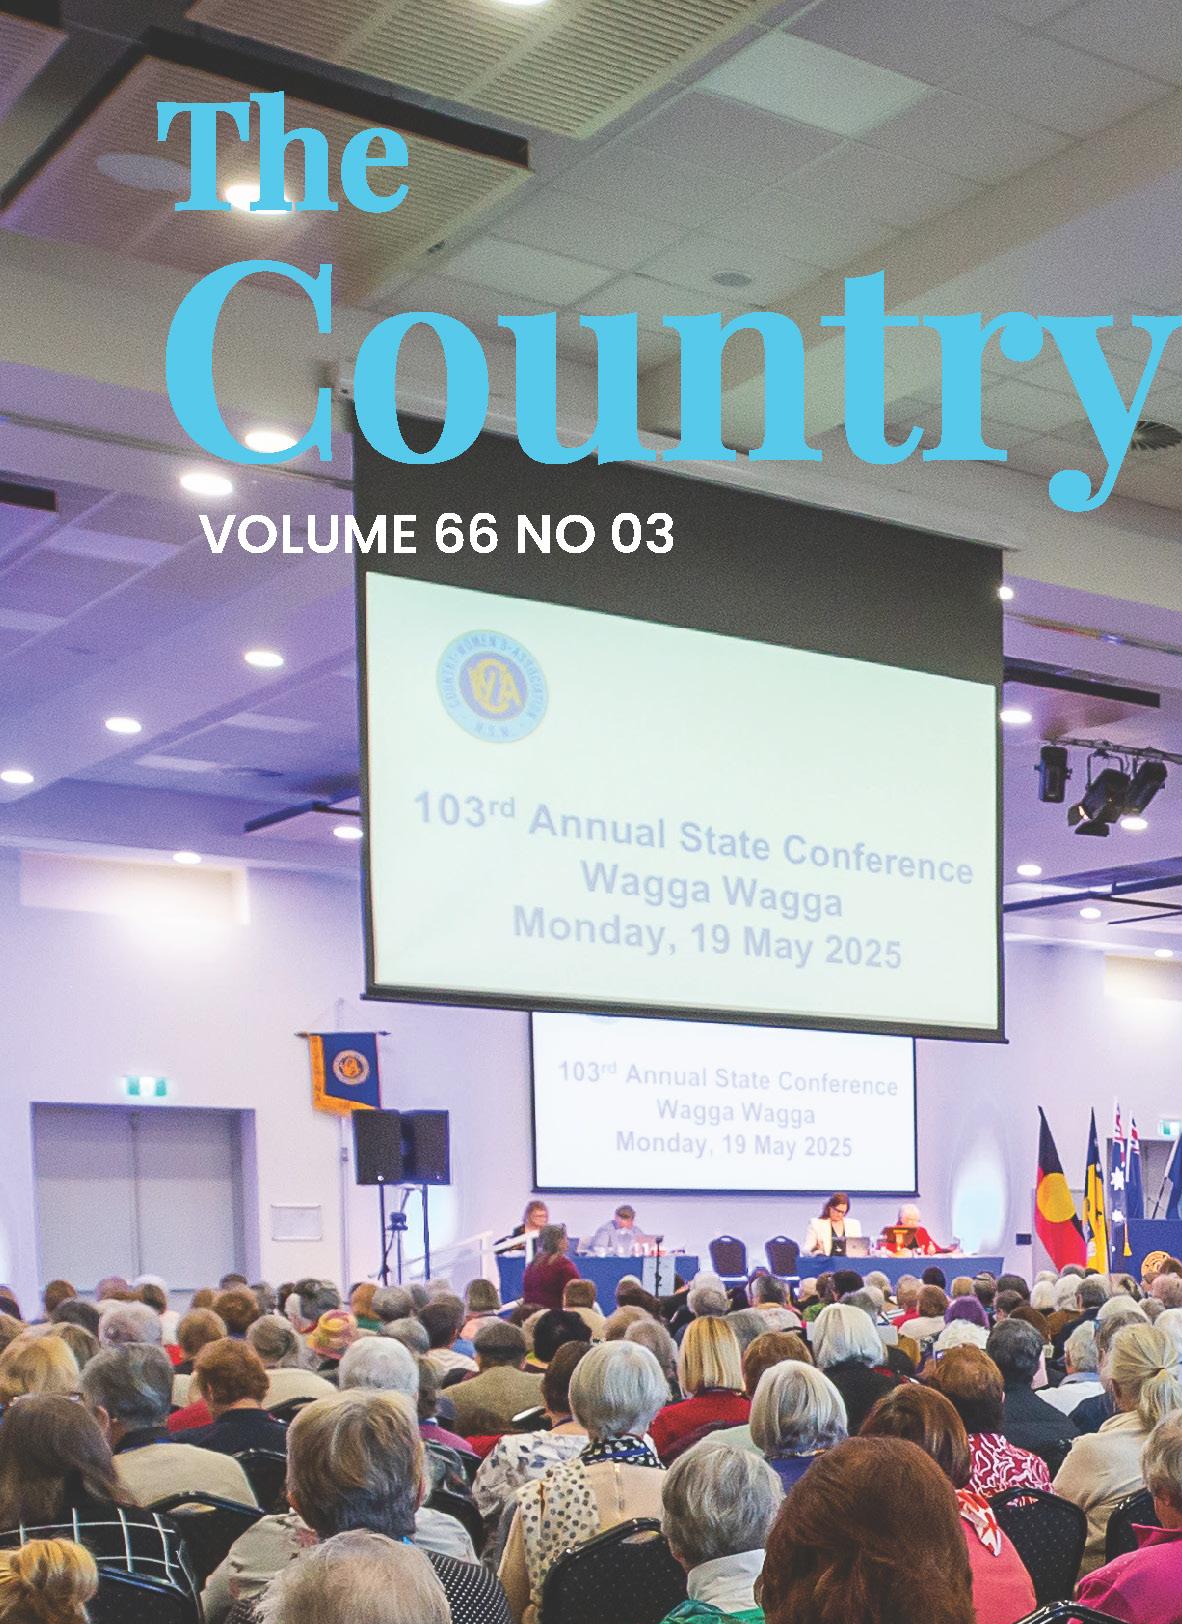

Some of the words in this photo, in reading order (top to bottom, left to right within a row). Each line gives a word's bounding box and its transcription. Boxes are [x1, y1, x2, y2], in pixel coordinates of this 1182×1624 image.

[414, 789, 516, 828] 103rd
[528, 803, 665, 848] Annual
[680, 821, 770, 861] State
[783, 834, 973, 884] Conference
[580, 859, 710, 909] Wagga
[722, 875, 842, 922] Wagga
[513, 904, 676, 956] Monday,
[691, 923, 730, 955] 19
[743, 926, 813, 969] May
[825, 935, 901, 969] 2025
[625, 1063, 707, 1088] Annual
[715, 1068, 770, 1091] State
[778, 1071, 899, 1097] Conference
[656, 1098, 735, 1127] Wagga
[741, 1101, 816, 1129] Wagga
[615, 1130, 714, 1160] Monday,
[723, 1133, 746, 1155] 19
[754, 1133, 796, 1161] May
[804, 1137, 853, 1158] 2025
